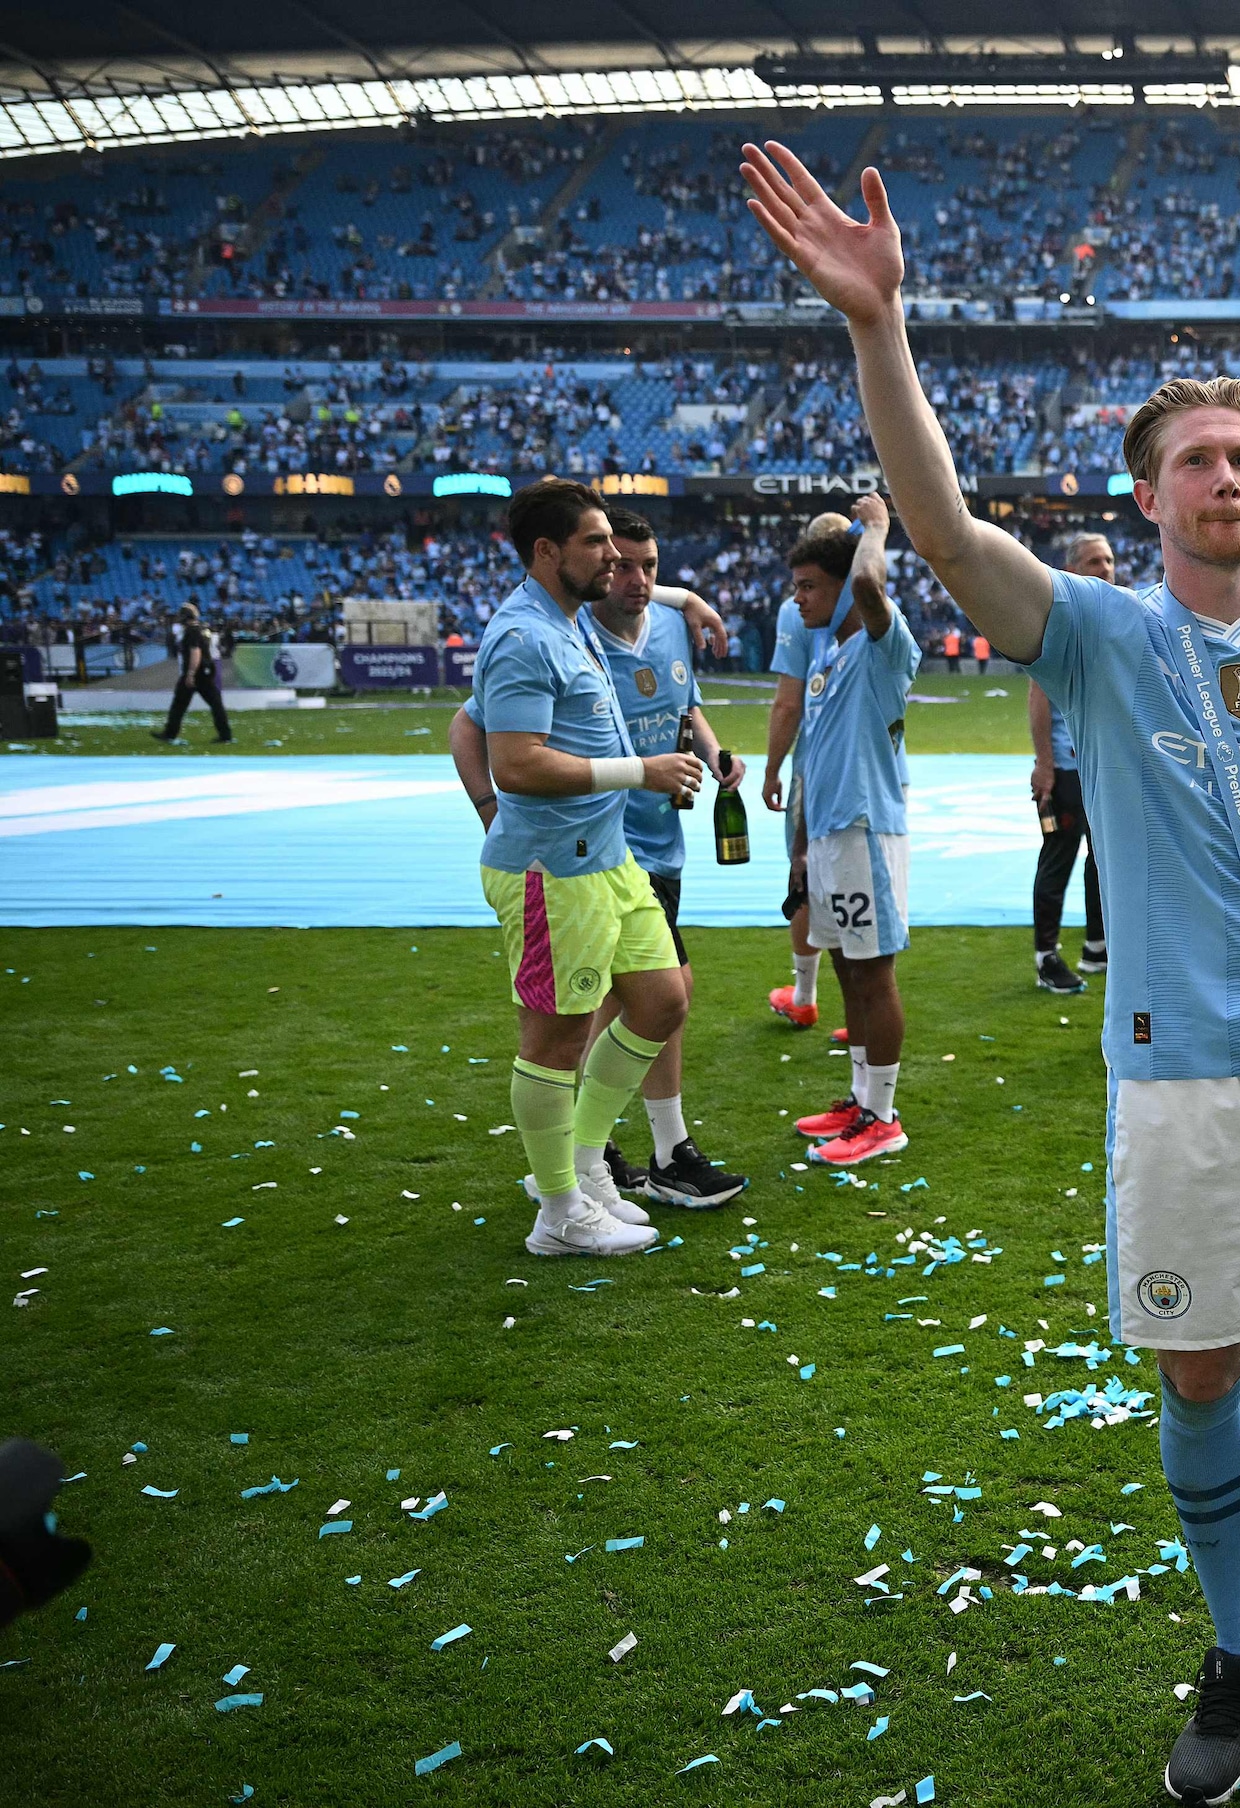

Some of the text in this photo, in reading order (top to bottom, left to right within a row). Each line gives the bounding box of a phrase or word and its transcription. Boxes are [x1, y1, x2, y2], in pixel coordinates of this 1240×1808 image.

[753, 474, 879, 494] ETIHAD
[1177, 624, 1203, 679] Premier
[1196, 681, 1222, 739] League
[633, 729, 677, 749] IRWAY
[831, 892, 872, 928] 52
[1142, 1273, 1186, 1290] MANCHESTER
